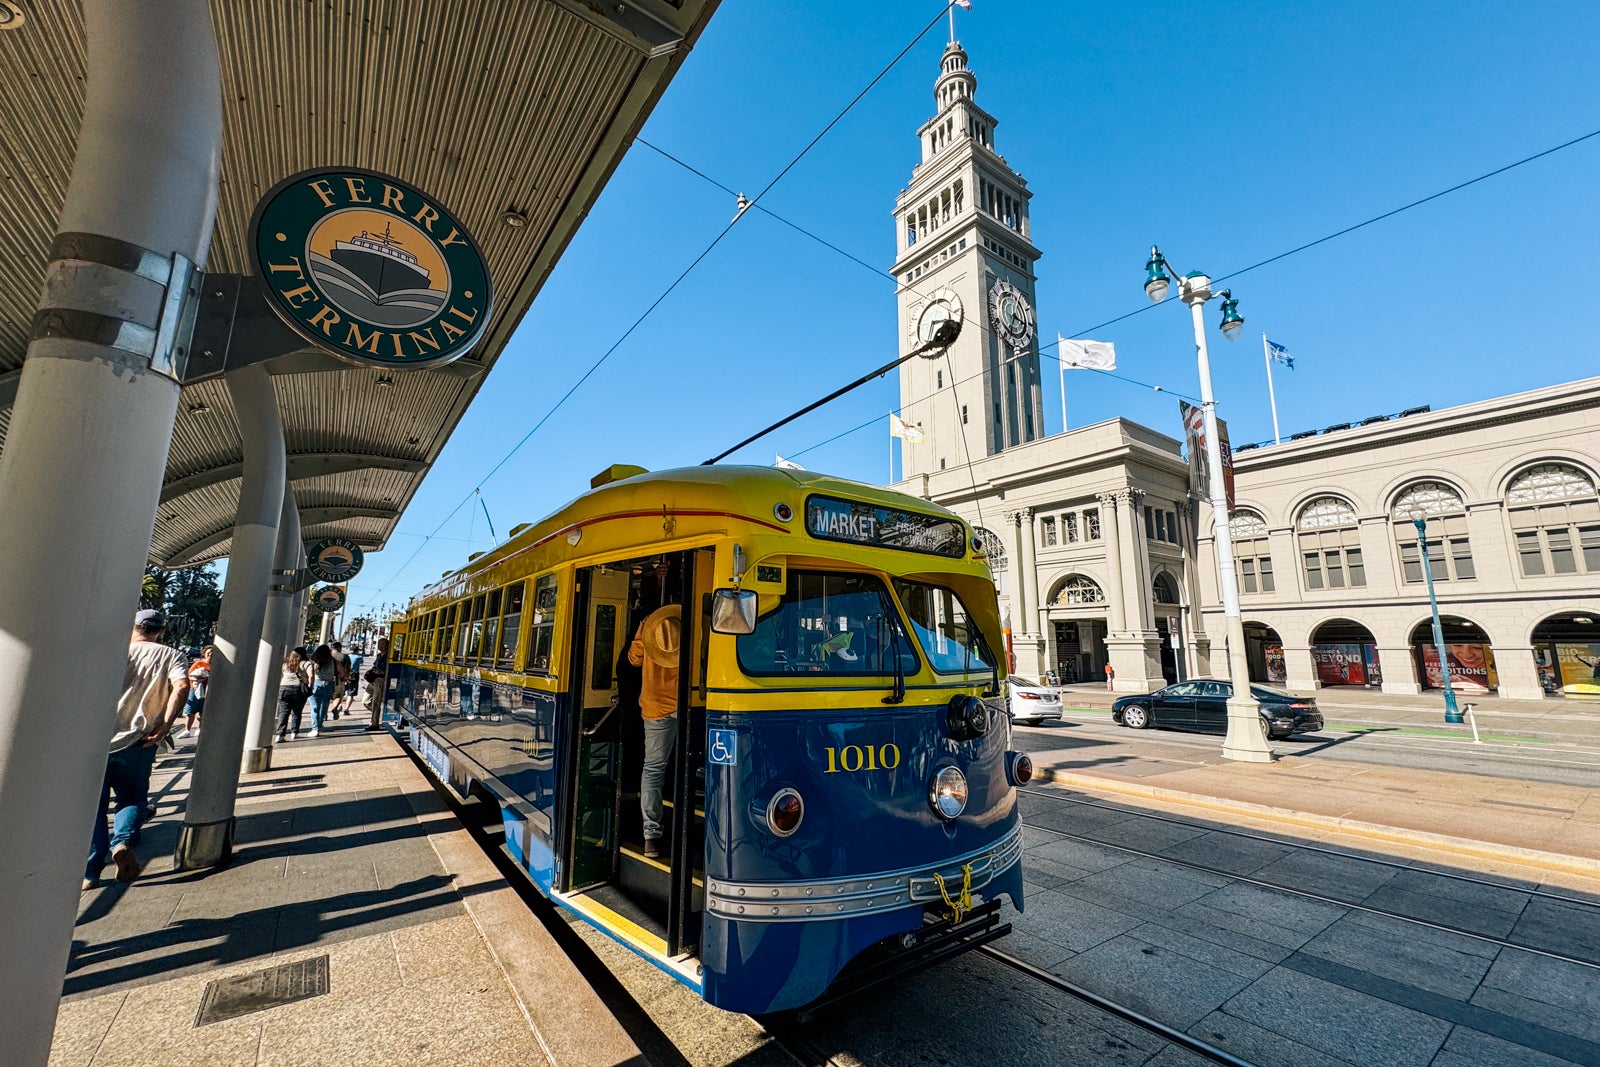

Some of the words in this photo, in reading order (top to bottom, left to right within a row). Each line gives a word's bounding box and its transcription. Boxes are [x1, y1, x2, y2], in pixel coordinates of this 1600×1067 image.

[308, 177, 468, 250] FERRY
[268, 255, 479, 358] TERMINAL
[816, 509, 877, 538] MARKET
[1314, 654, 1361, 663] BEYOND
[1424, 667, 1487, 675] TRDITIONS
[823, 743, 901, 773] 1010
